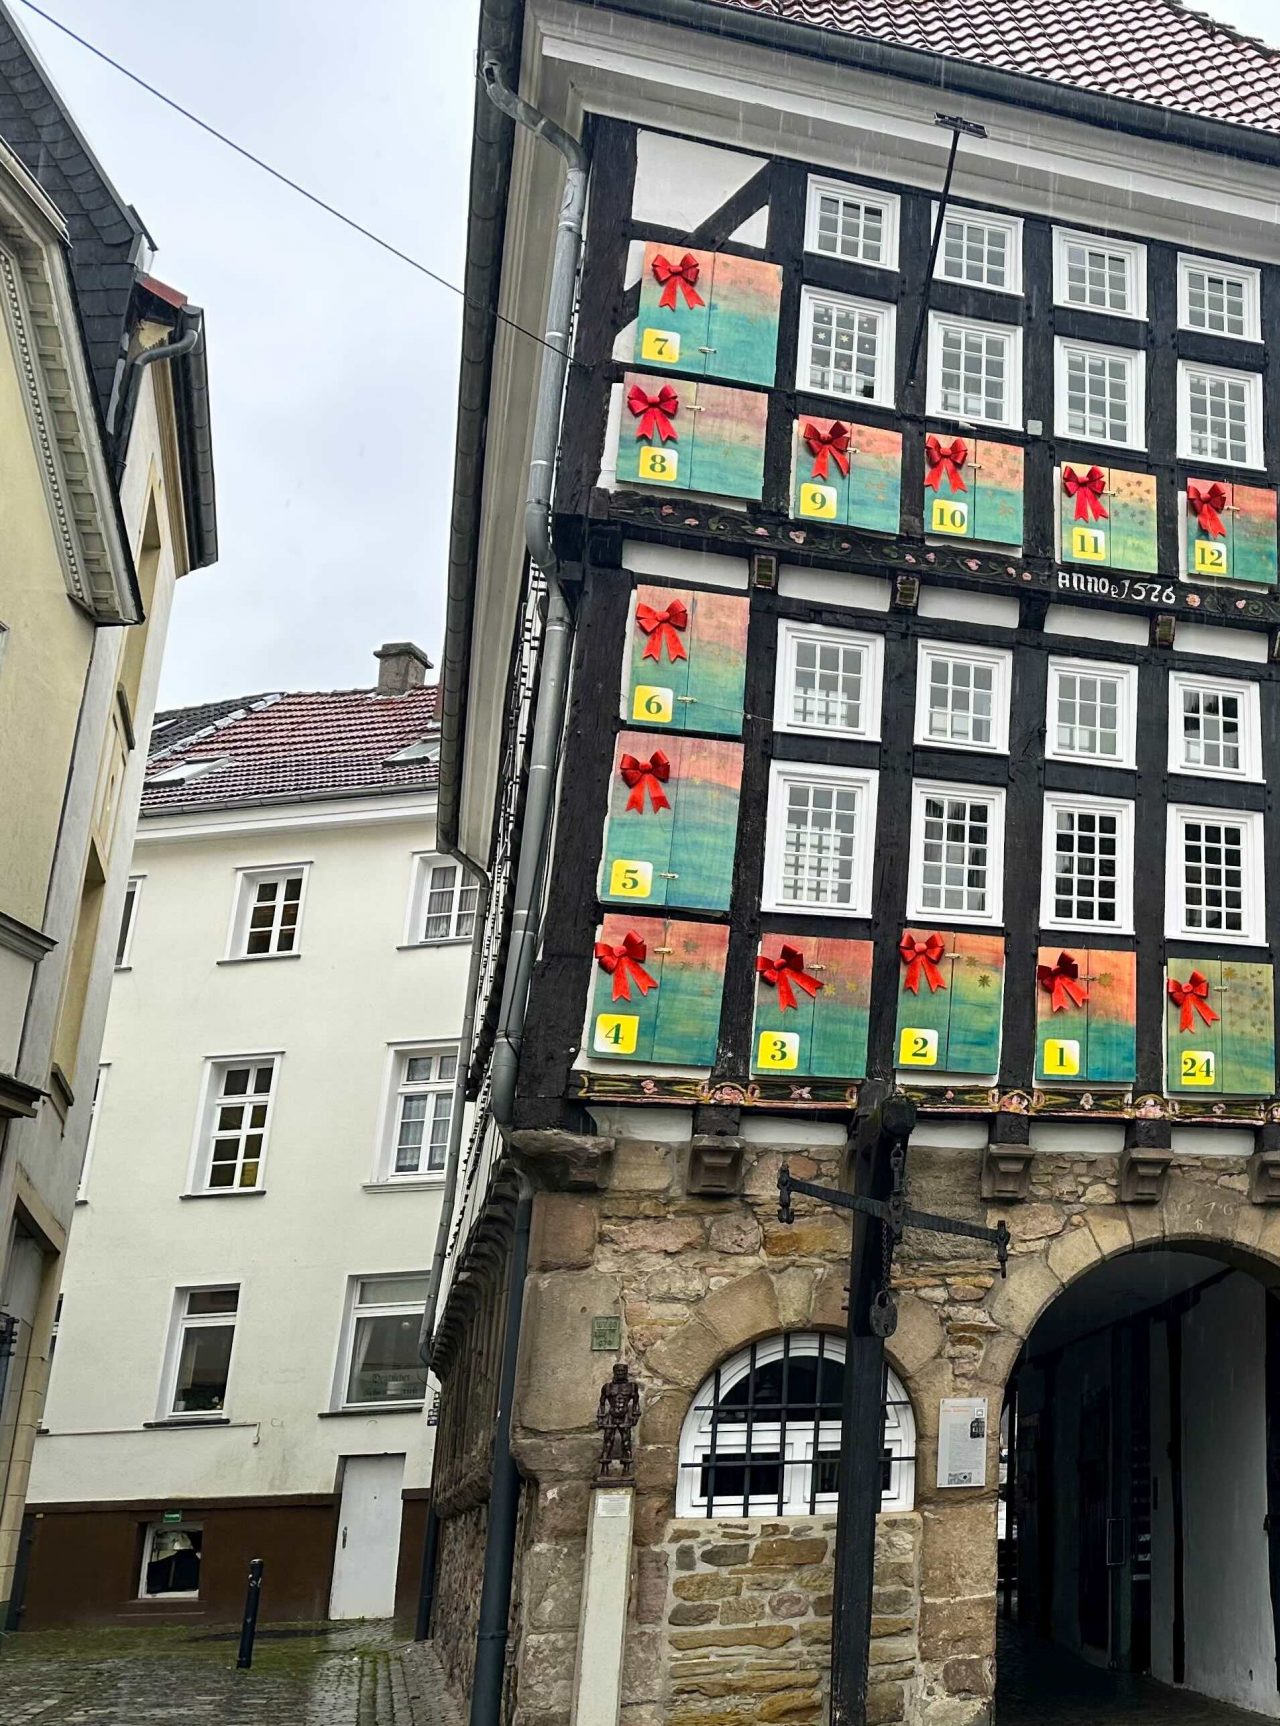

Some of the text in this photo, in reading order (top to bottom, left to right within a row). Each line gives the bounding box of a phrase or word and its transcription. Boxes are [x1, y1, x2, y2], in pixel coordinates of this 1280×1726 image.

[653, 337, 669, 355] 7
[649, 454, 666, 473] 8
[810, 492, 827, 510] 9
[936, 508, 965, 528] 10
[1078, 534, 1100, 554] 11
[1199, 547, 1223, 567] 12
[645, 695, 662, 714] 6
[622, 869, 639, 889] 5
[605, 1023, 624, 1045] 4
[770, 1040, 787, 1061] 3
[912, 1037, 928, 1057] 2
[1056, 1047, 1067, 1067] 1
[1183, 1057, 1214, 1078] 24
